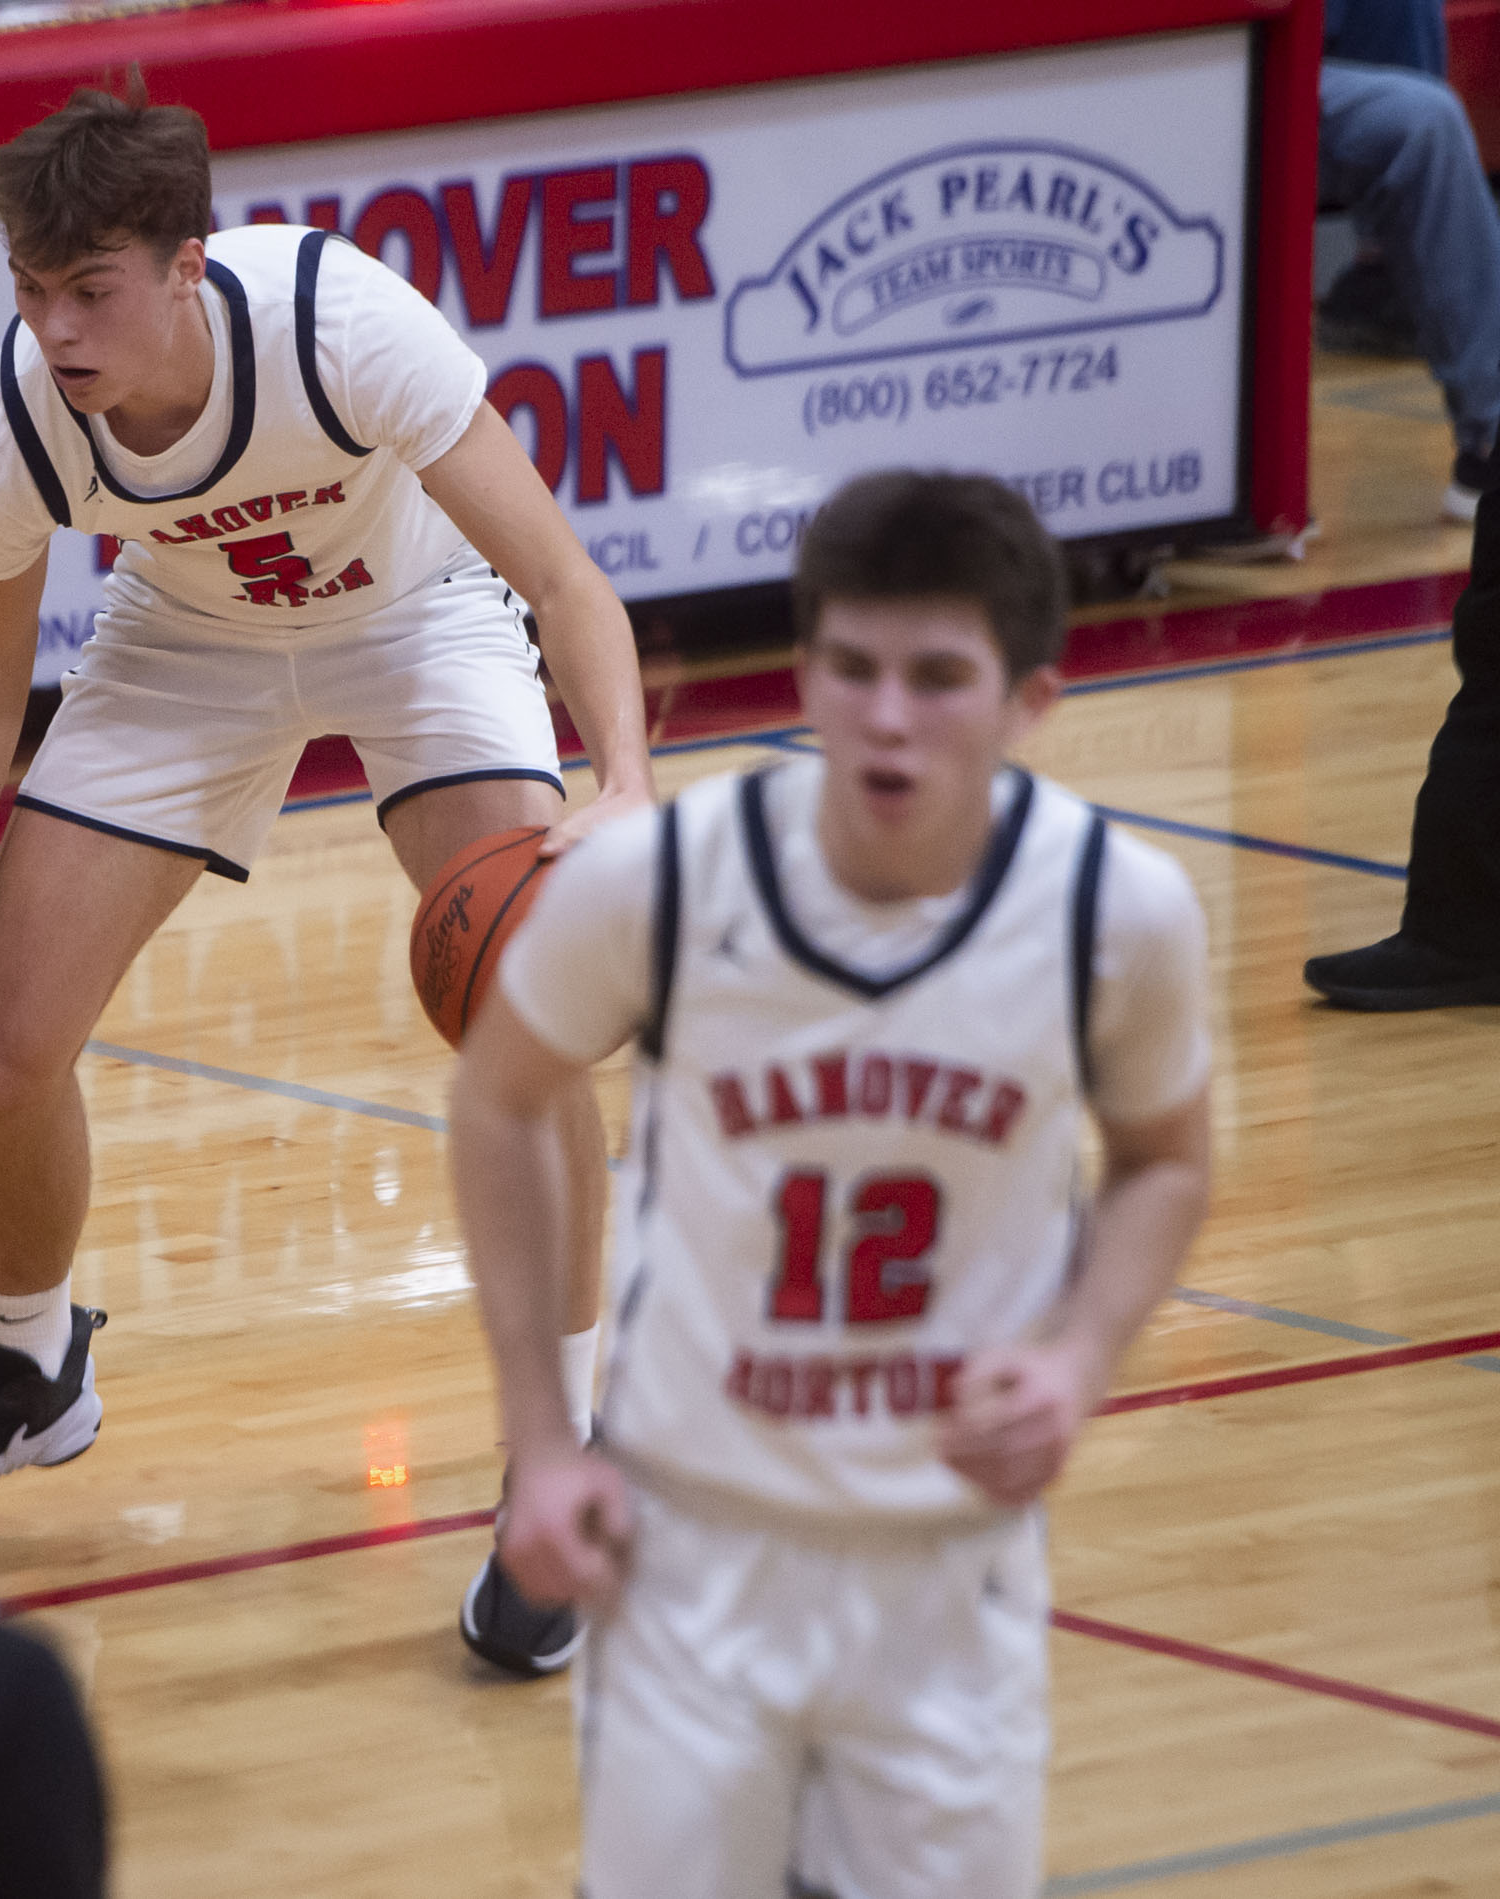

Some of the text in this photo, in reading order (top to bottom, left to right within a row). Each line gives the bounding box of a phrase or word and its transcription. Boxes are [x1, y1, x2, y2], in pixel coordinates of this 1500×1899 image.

[789, 165, 1160, 334] JACK PEARL'S
[871, 246, 1071, 306] TEAM SPORTS
[802, 343, 1119, 437] (800) 652-7724
[1097, 449, 1203, 505] CLUB
[706, 1049, 1029, 1145] HANOVER
[766, 1166, 944, 1328] 12
